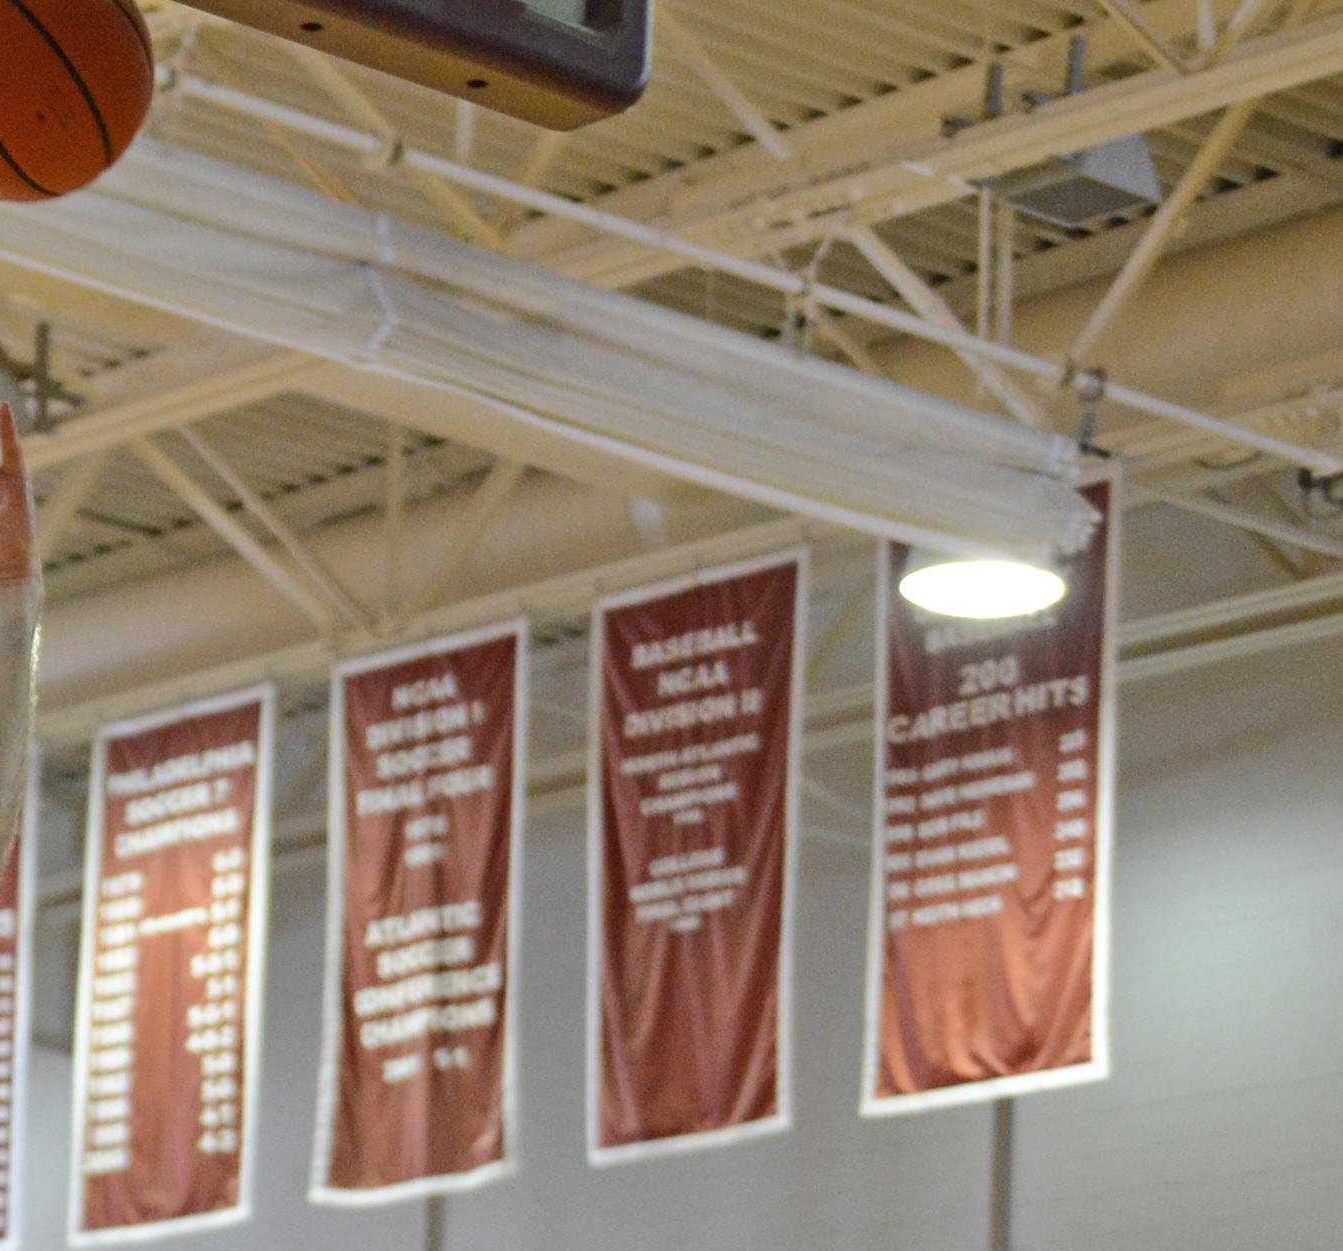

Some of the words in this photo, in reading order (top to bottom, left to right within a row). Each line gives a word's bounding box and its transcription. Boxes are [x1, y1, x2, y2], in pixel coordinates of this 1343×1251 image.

[630, 620, 759, 670] BASEBALL
[392, 673, 458, 711] NCAA
[656, 660, 730, 697] NCAA
[958, 654, 1021, 696] 200
[365, 702, 469, 750] DIVISION
[623, 693, 738, 738] DIVISION
[886, 691, 1012, 744] CAREER
[1014, 674, 1090, 716] HITS
[107, 740, 256, 794] PHILADELPHIA
[376, 735, 473, 780] SOCCER
[124, 781, 212, 825] SOCCER
[356, 780, 425, 818] FINAL
[114, 807, 241, 860] CHAMPIONS
[365, 900, 482, 949] ATLANTIC
[376, 936, 474, 980] SOCCER
[354, 961, 502, 1017] CONFERENCE
[360, 998, 497, 1050] CHAMPIONS
